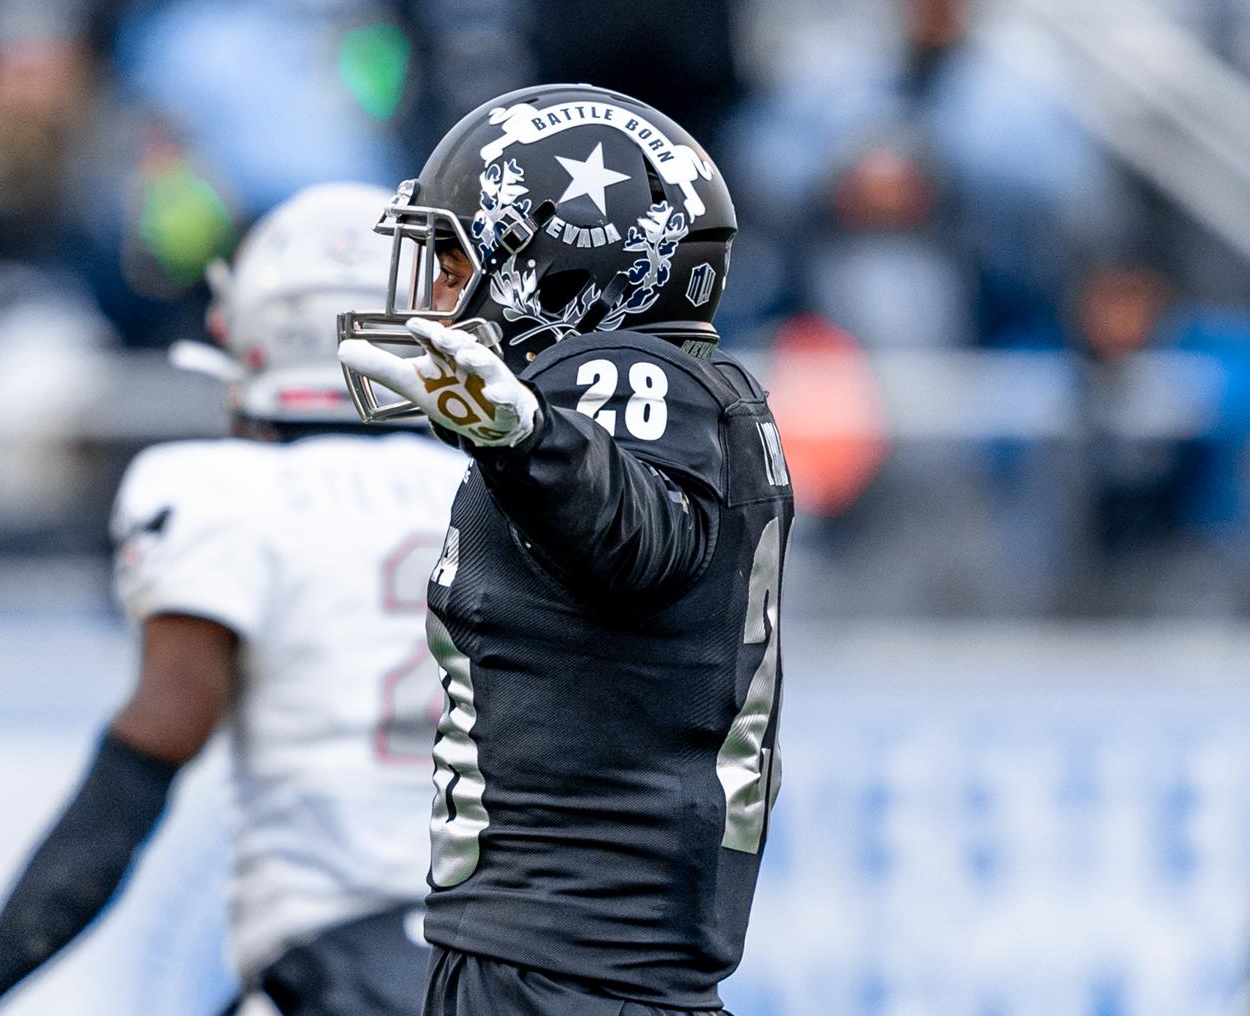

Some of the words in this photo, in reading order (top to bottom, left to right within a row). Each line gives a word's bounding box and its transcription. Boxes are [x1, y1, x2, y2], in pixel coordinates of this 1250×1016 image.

[531, 106, 614, 131] BATTLE
[624, 118, 674, 163] BORN
[545, 216, 622, 248] EVADA
[576, 359, 668, 441] 28
